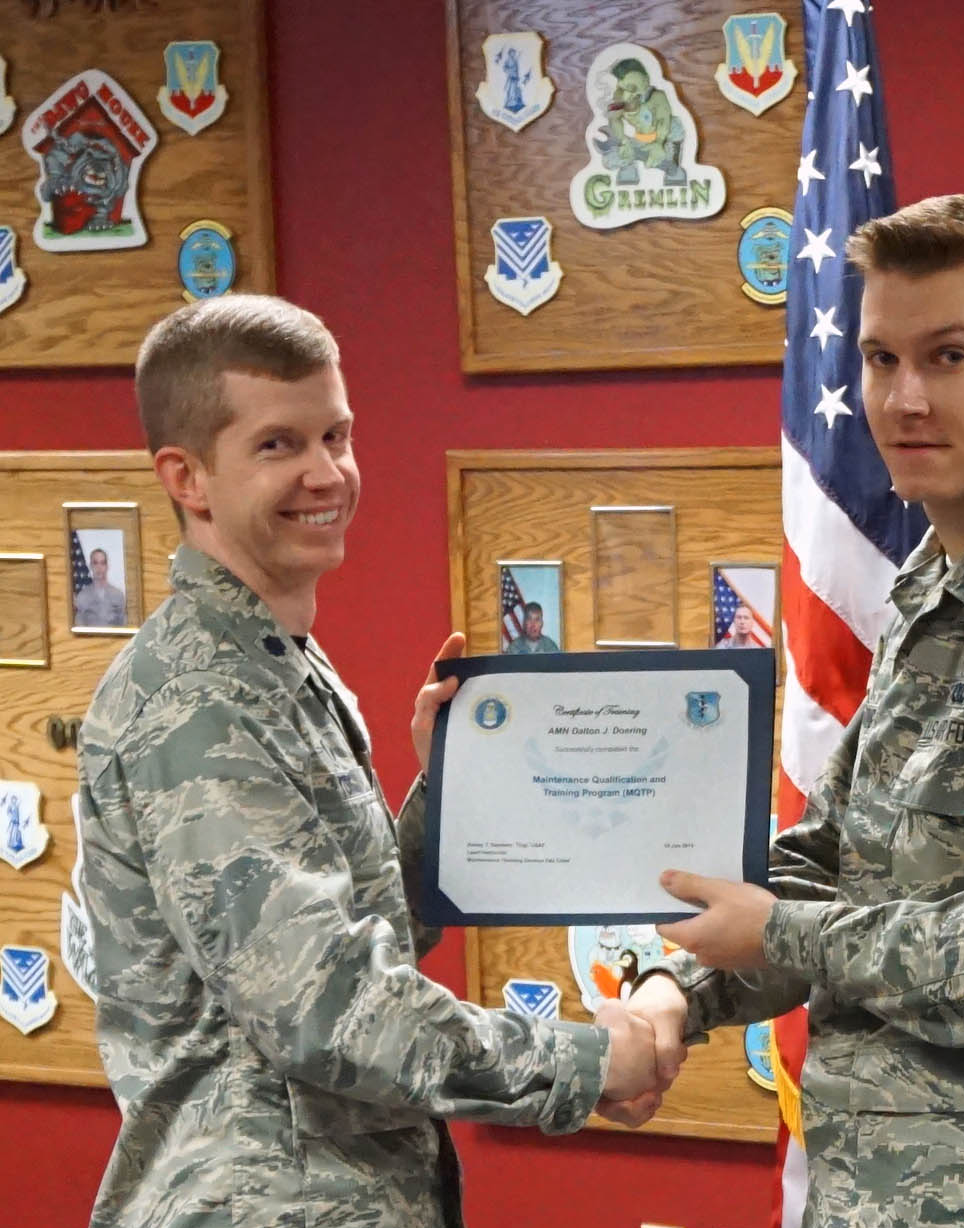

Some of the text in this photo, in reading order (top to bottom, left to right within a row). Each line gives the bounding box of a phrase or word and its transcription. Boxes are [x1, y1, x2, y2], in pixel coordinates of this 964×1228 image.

[548, 727, 569, 735] AMN
[571, 727, 600, 736] Dalton
[612, 726, 648, 737] Doering
[532, 775, 667, 784] Maintenance Qualification and
[543, 788, 656, 798] Training Program (MQTP)
